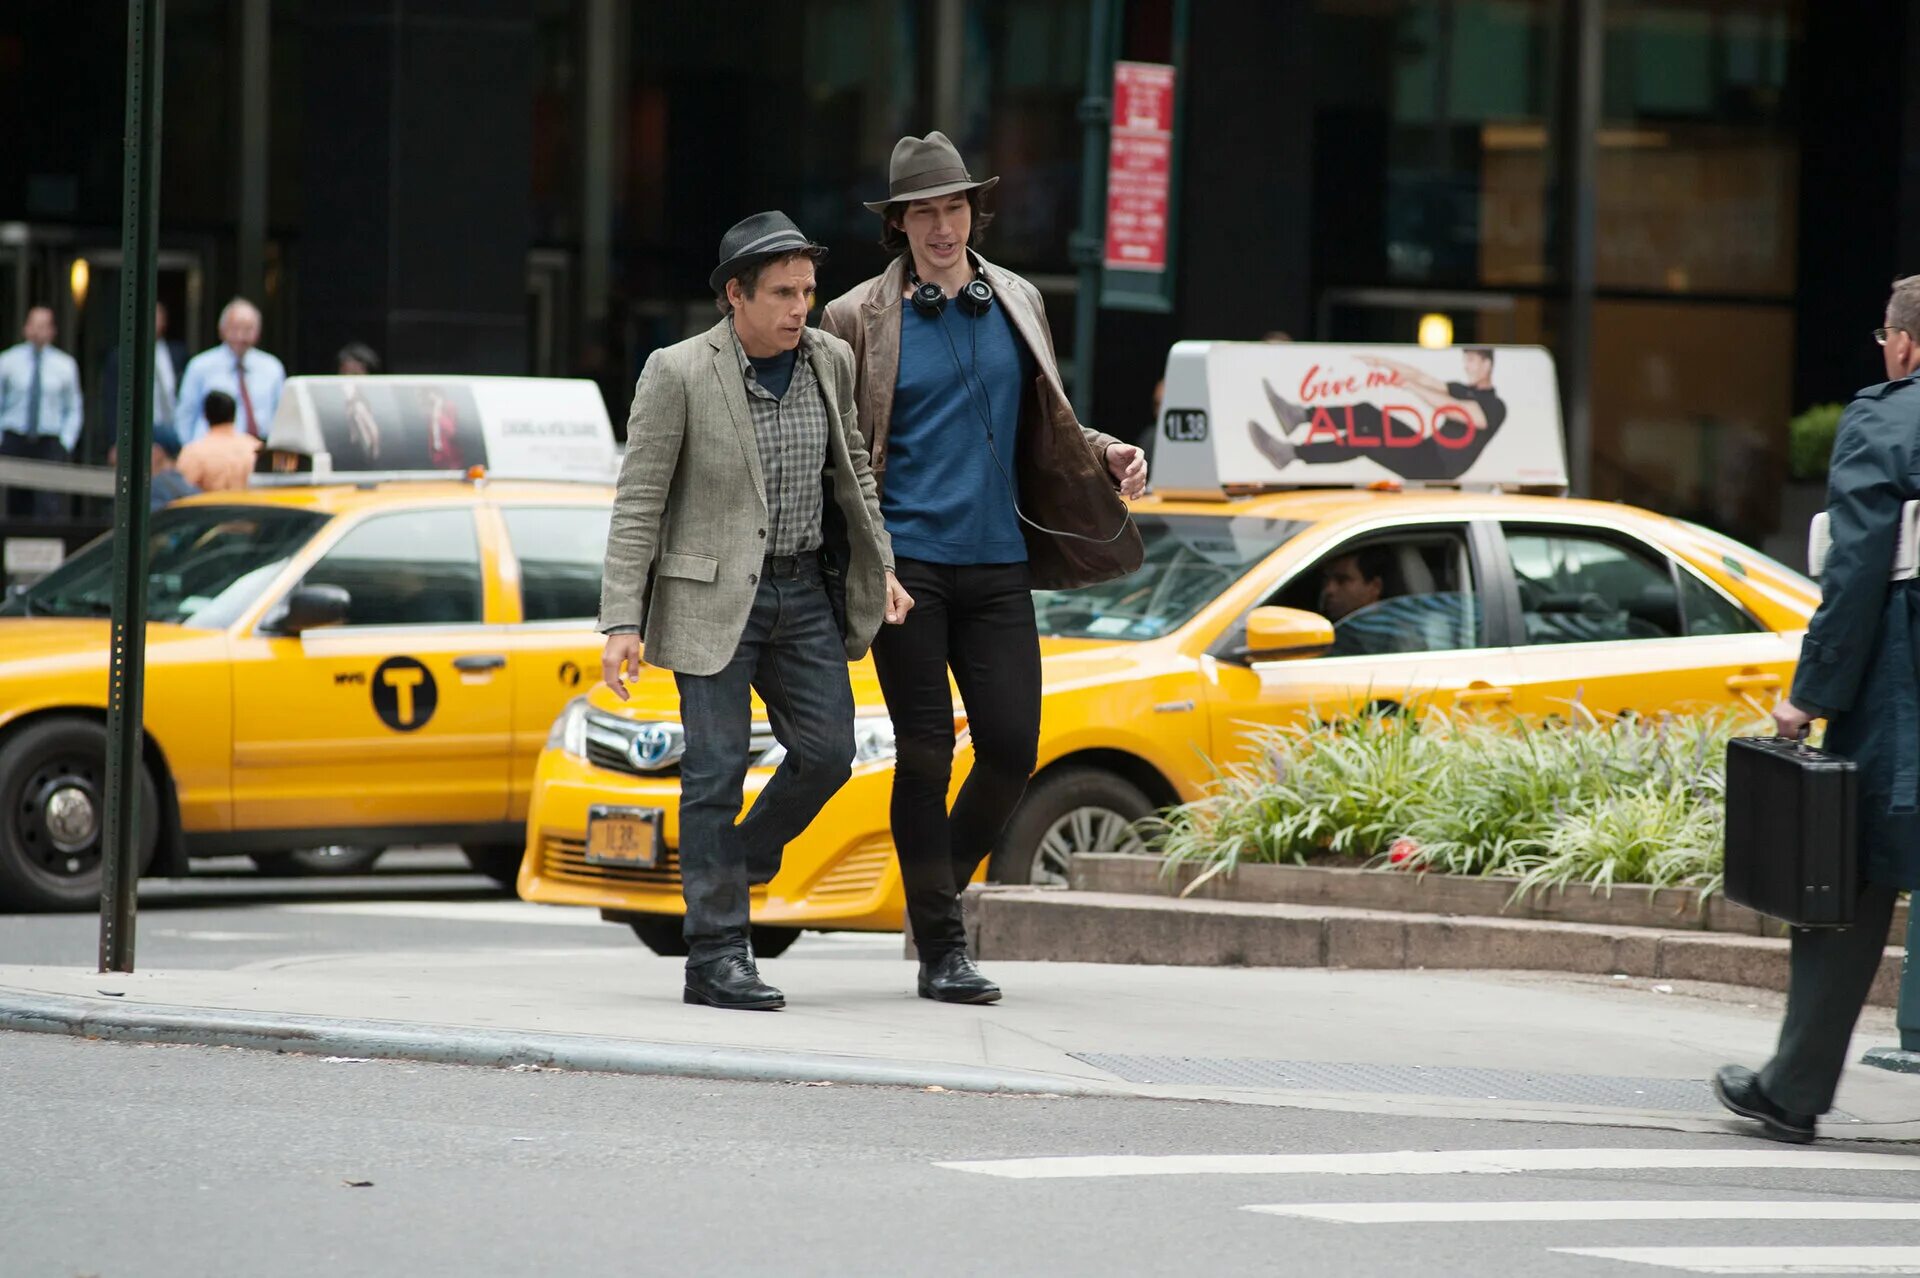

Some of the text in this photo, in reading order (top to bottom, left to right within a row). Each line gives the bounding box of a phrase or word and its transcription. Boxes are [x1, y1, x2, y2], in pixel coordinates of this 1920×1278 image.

[1299, 364, 1407, 402] Give me
[1305, 403, 1476, 450] ALDO
[383, 666, 424, 726] T
